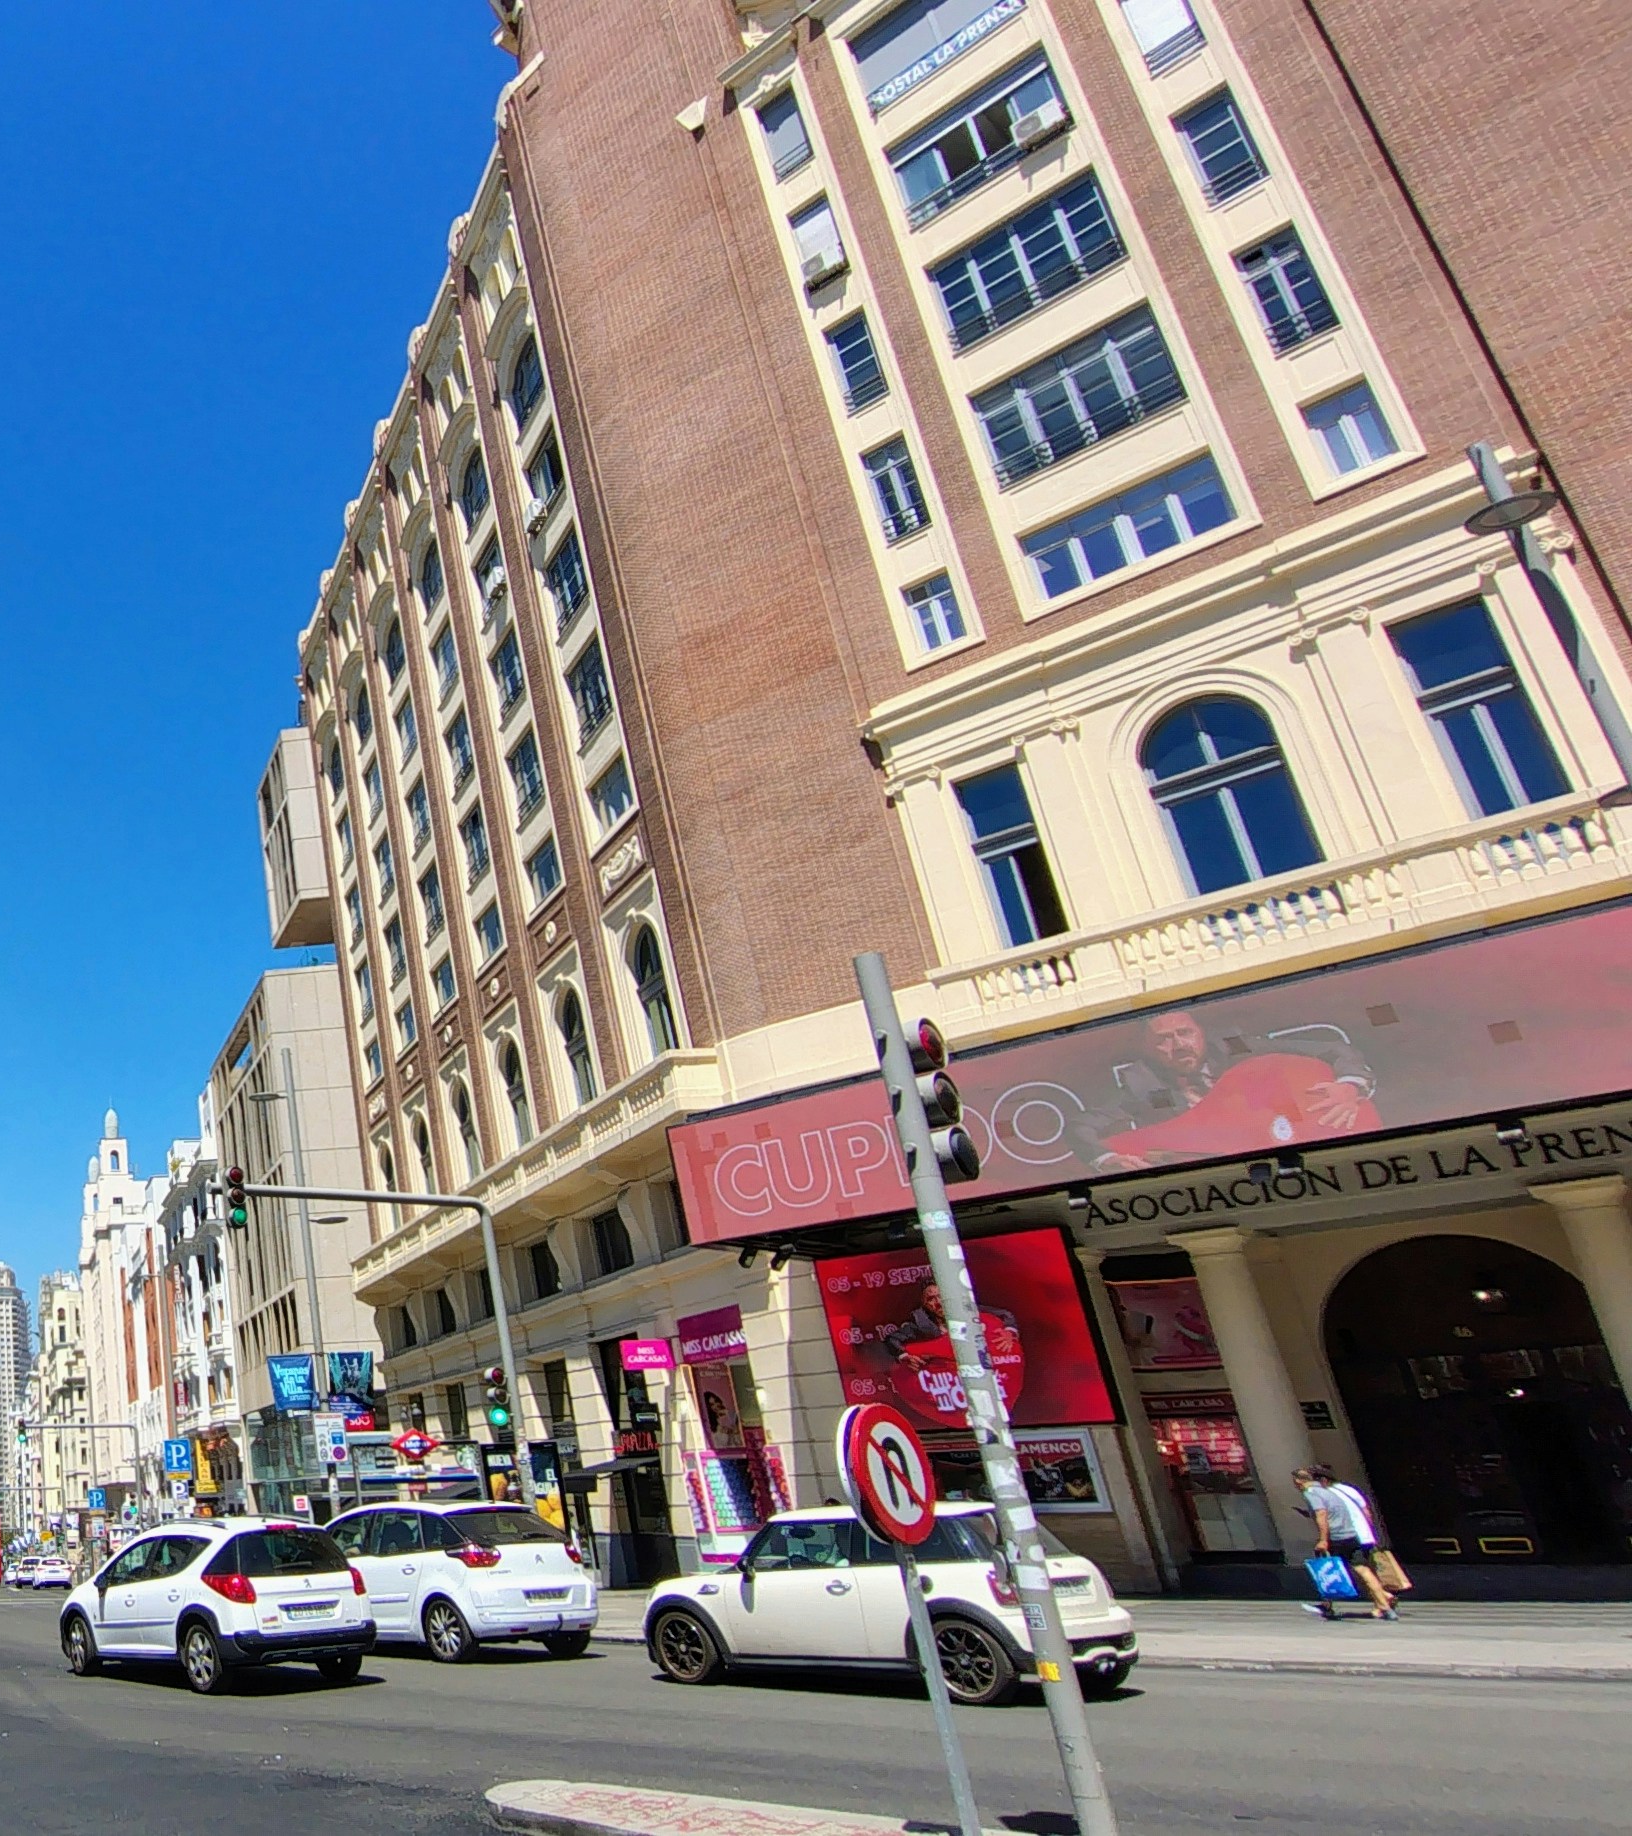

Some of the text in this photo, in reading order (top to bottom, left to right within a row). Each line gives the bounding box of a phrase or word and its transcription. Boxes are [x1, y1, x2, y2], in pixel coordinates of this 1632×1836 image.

[933, 41, 956, 65] LA
[1359, 1155, 1418, 1190] DE
[1429, 1143, 1501, 1181] LA
[827, 1276, 850, 1293] 05
[862, 1271, 885, 1288] 19
[887, 1264, 933, 1286] SEPTI
[682, 1329, 747, 1355] MISS CARCASAS
[839, 1327, 863, 1345] 05
[851, 1378, 876, 1396] 05
[405, 1440, 428, 1450] Metro
[1016, 1441, 1082, 1455] LAMENCO
